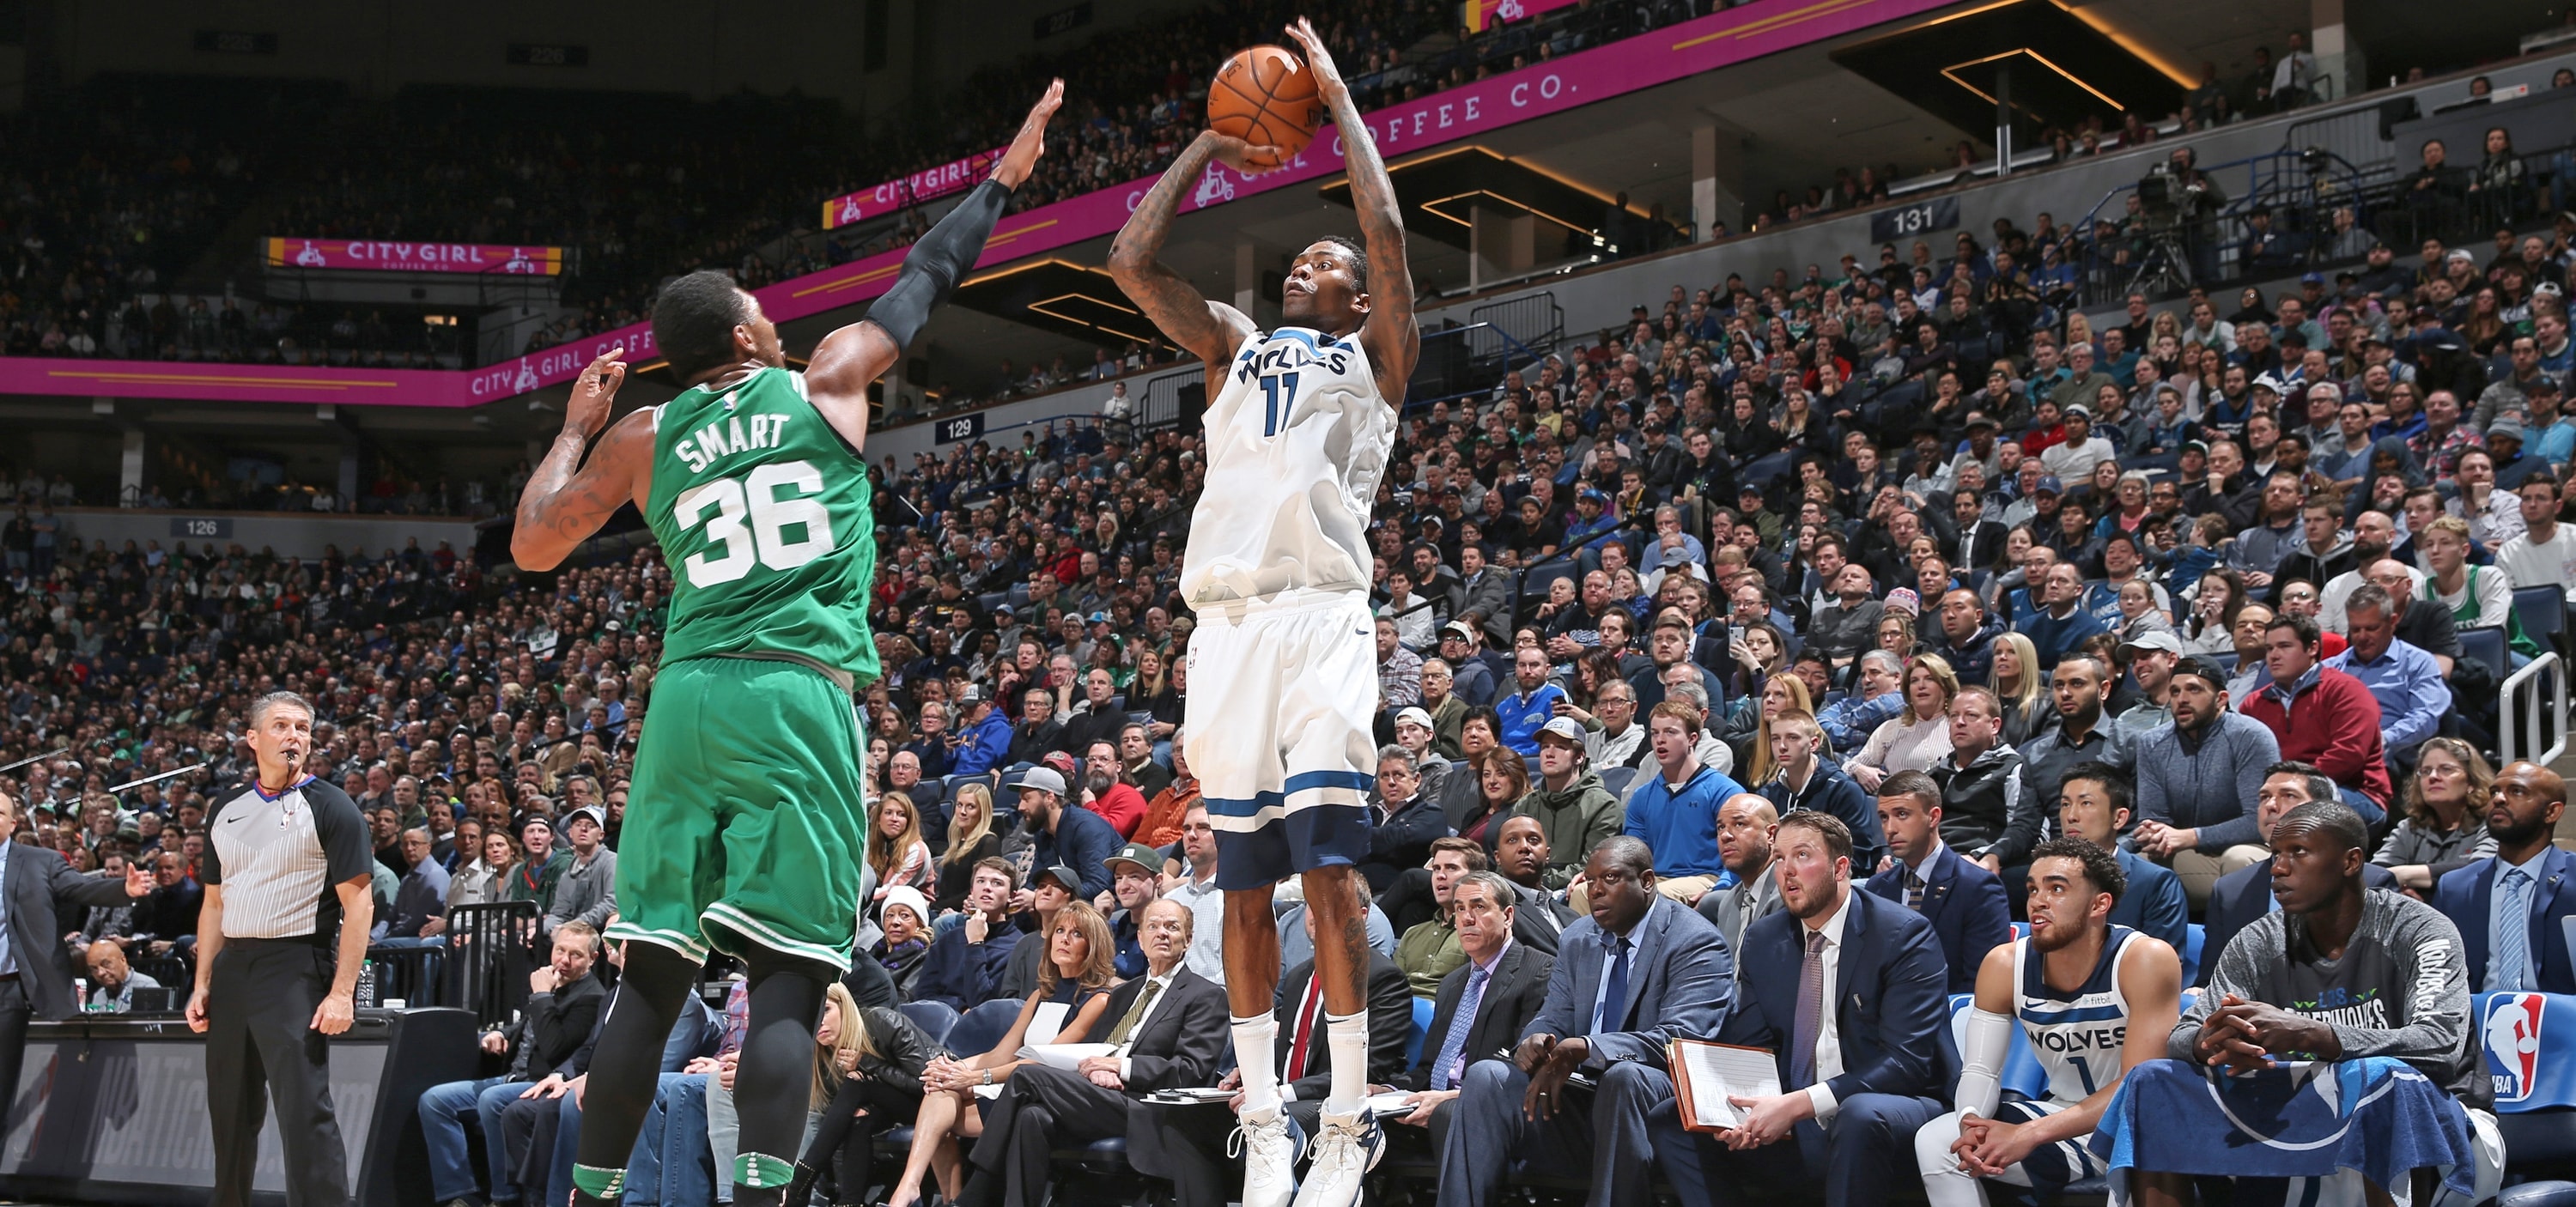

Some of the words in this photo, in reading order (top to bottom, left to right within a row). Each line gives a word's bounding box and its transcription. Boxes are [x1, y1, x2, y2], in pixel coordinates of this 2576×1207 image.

[530, 46, 565, 64] 226
[1510, 74, 1578, 107] CO.
[925, 160, 972, 188] GIRL
[1893, 205, 1933, 234] 131
[347, 241, 412, 260] CITY
[419, 246, 484, 264] GIRL
[472, 370, 512, 396] CITY
[541, 349, 582, 376] GIRL
[1259, 371, 1300, 438] 11
[947, 418, 972, 439] 129
[675, 413, 792, 474] SMART
[187, 520, 217, 536] 126
[673, 459, 836, 590] 36
[2090, 996, 2111, 1006] fitbit
[2318, 987, 2348, 1009] LOS
[2023, 1026, 2127, 1053] WOLVES
[2066, 1056, 2097, 1096] 1
[2491, 1074, 2512, 1095] BA
